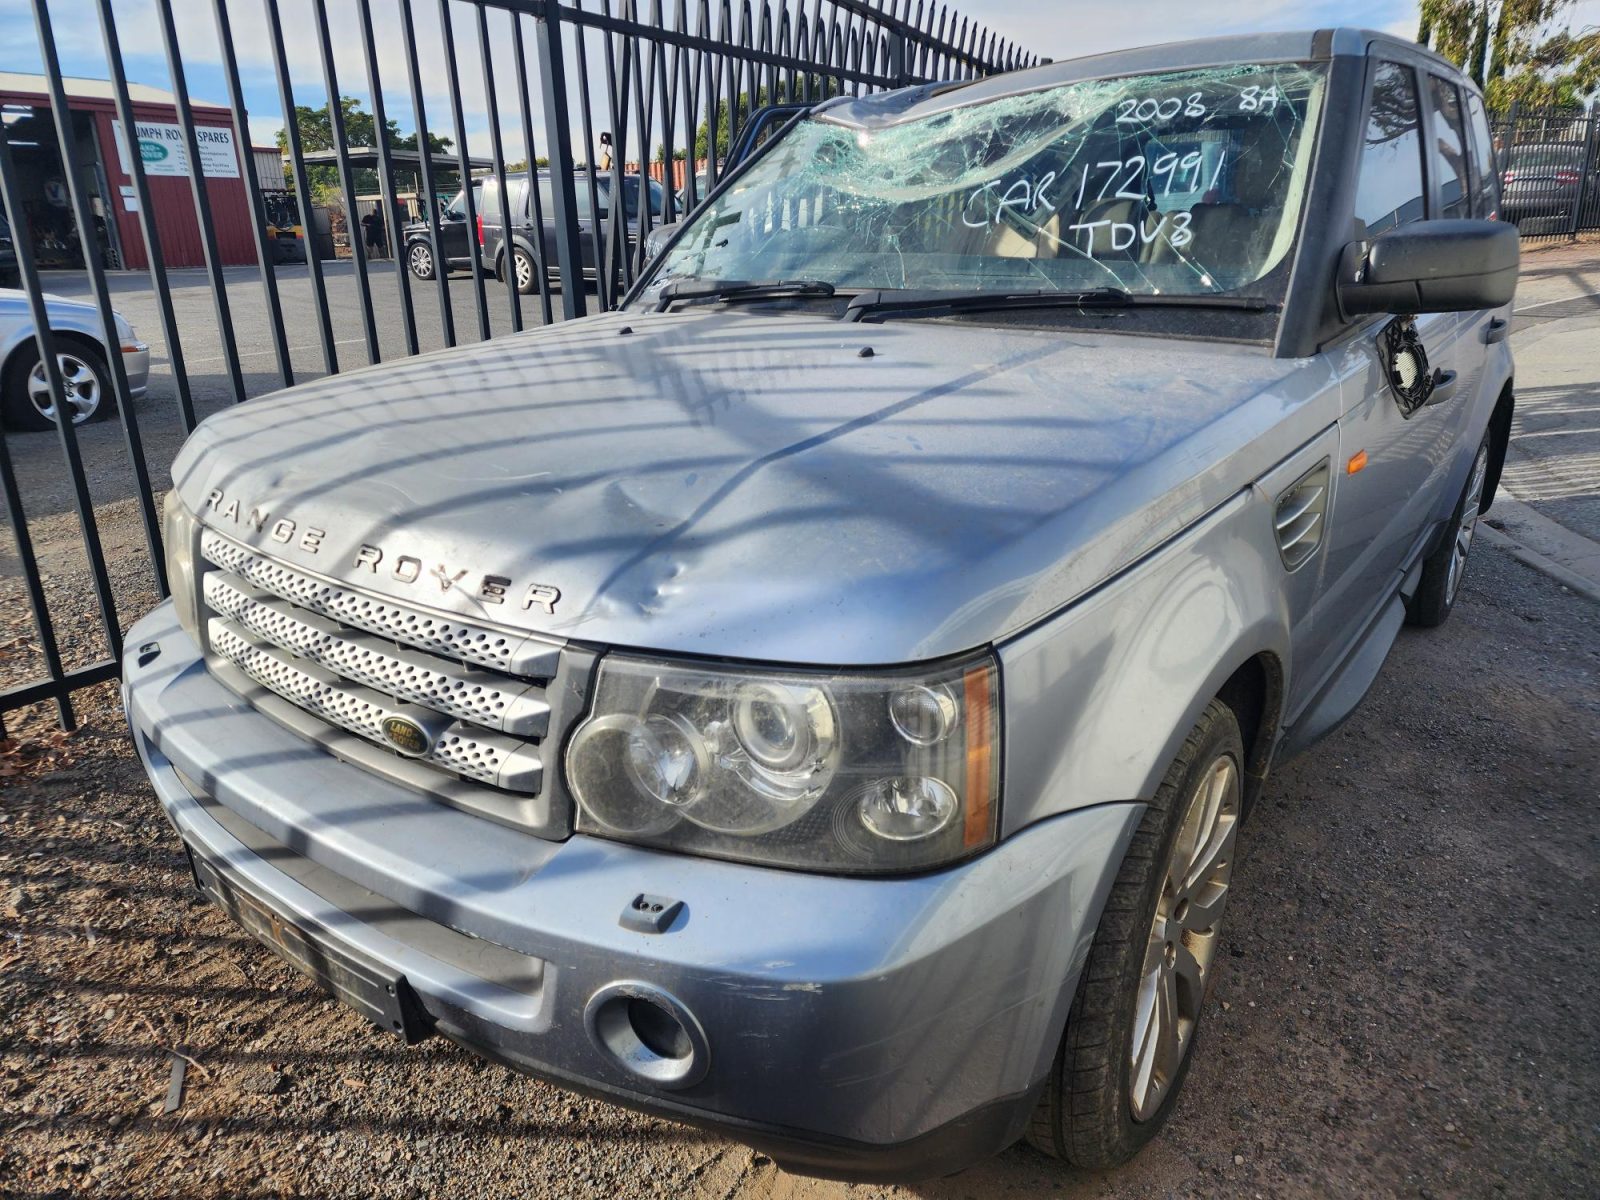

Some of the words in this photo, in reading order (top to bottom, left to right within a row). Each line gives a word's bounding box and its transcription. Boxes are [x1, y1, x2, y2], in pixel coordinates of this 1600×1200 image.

[1116, 92, 1206, 122] 2008
[197, 131, 230, 144] SPARES
[962, 171, 1056, 228] CAR
[1075, 150, 1226, 210] 172991
[1069, 212, 1193, 258] TDV8
[205, 488, 327, 554] RANGE
[353, 543, 562, 615] ROVER
